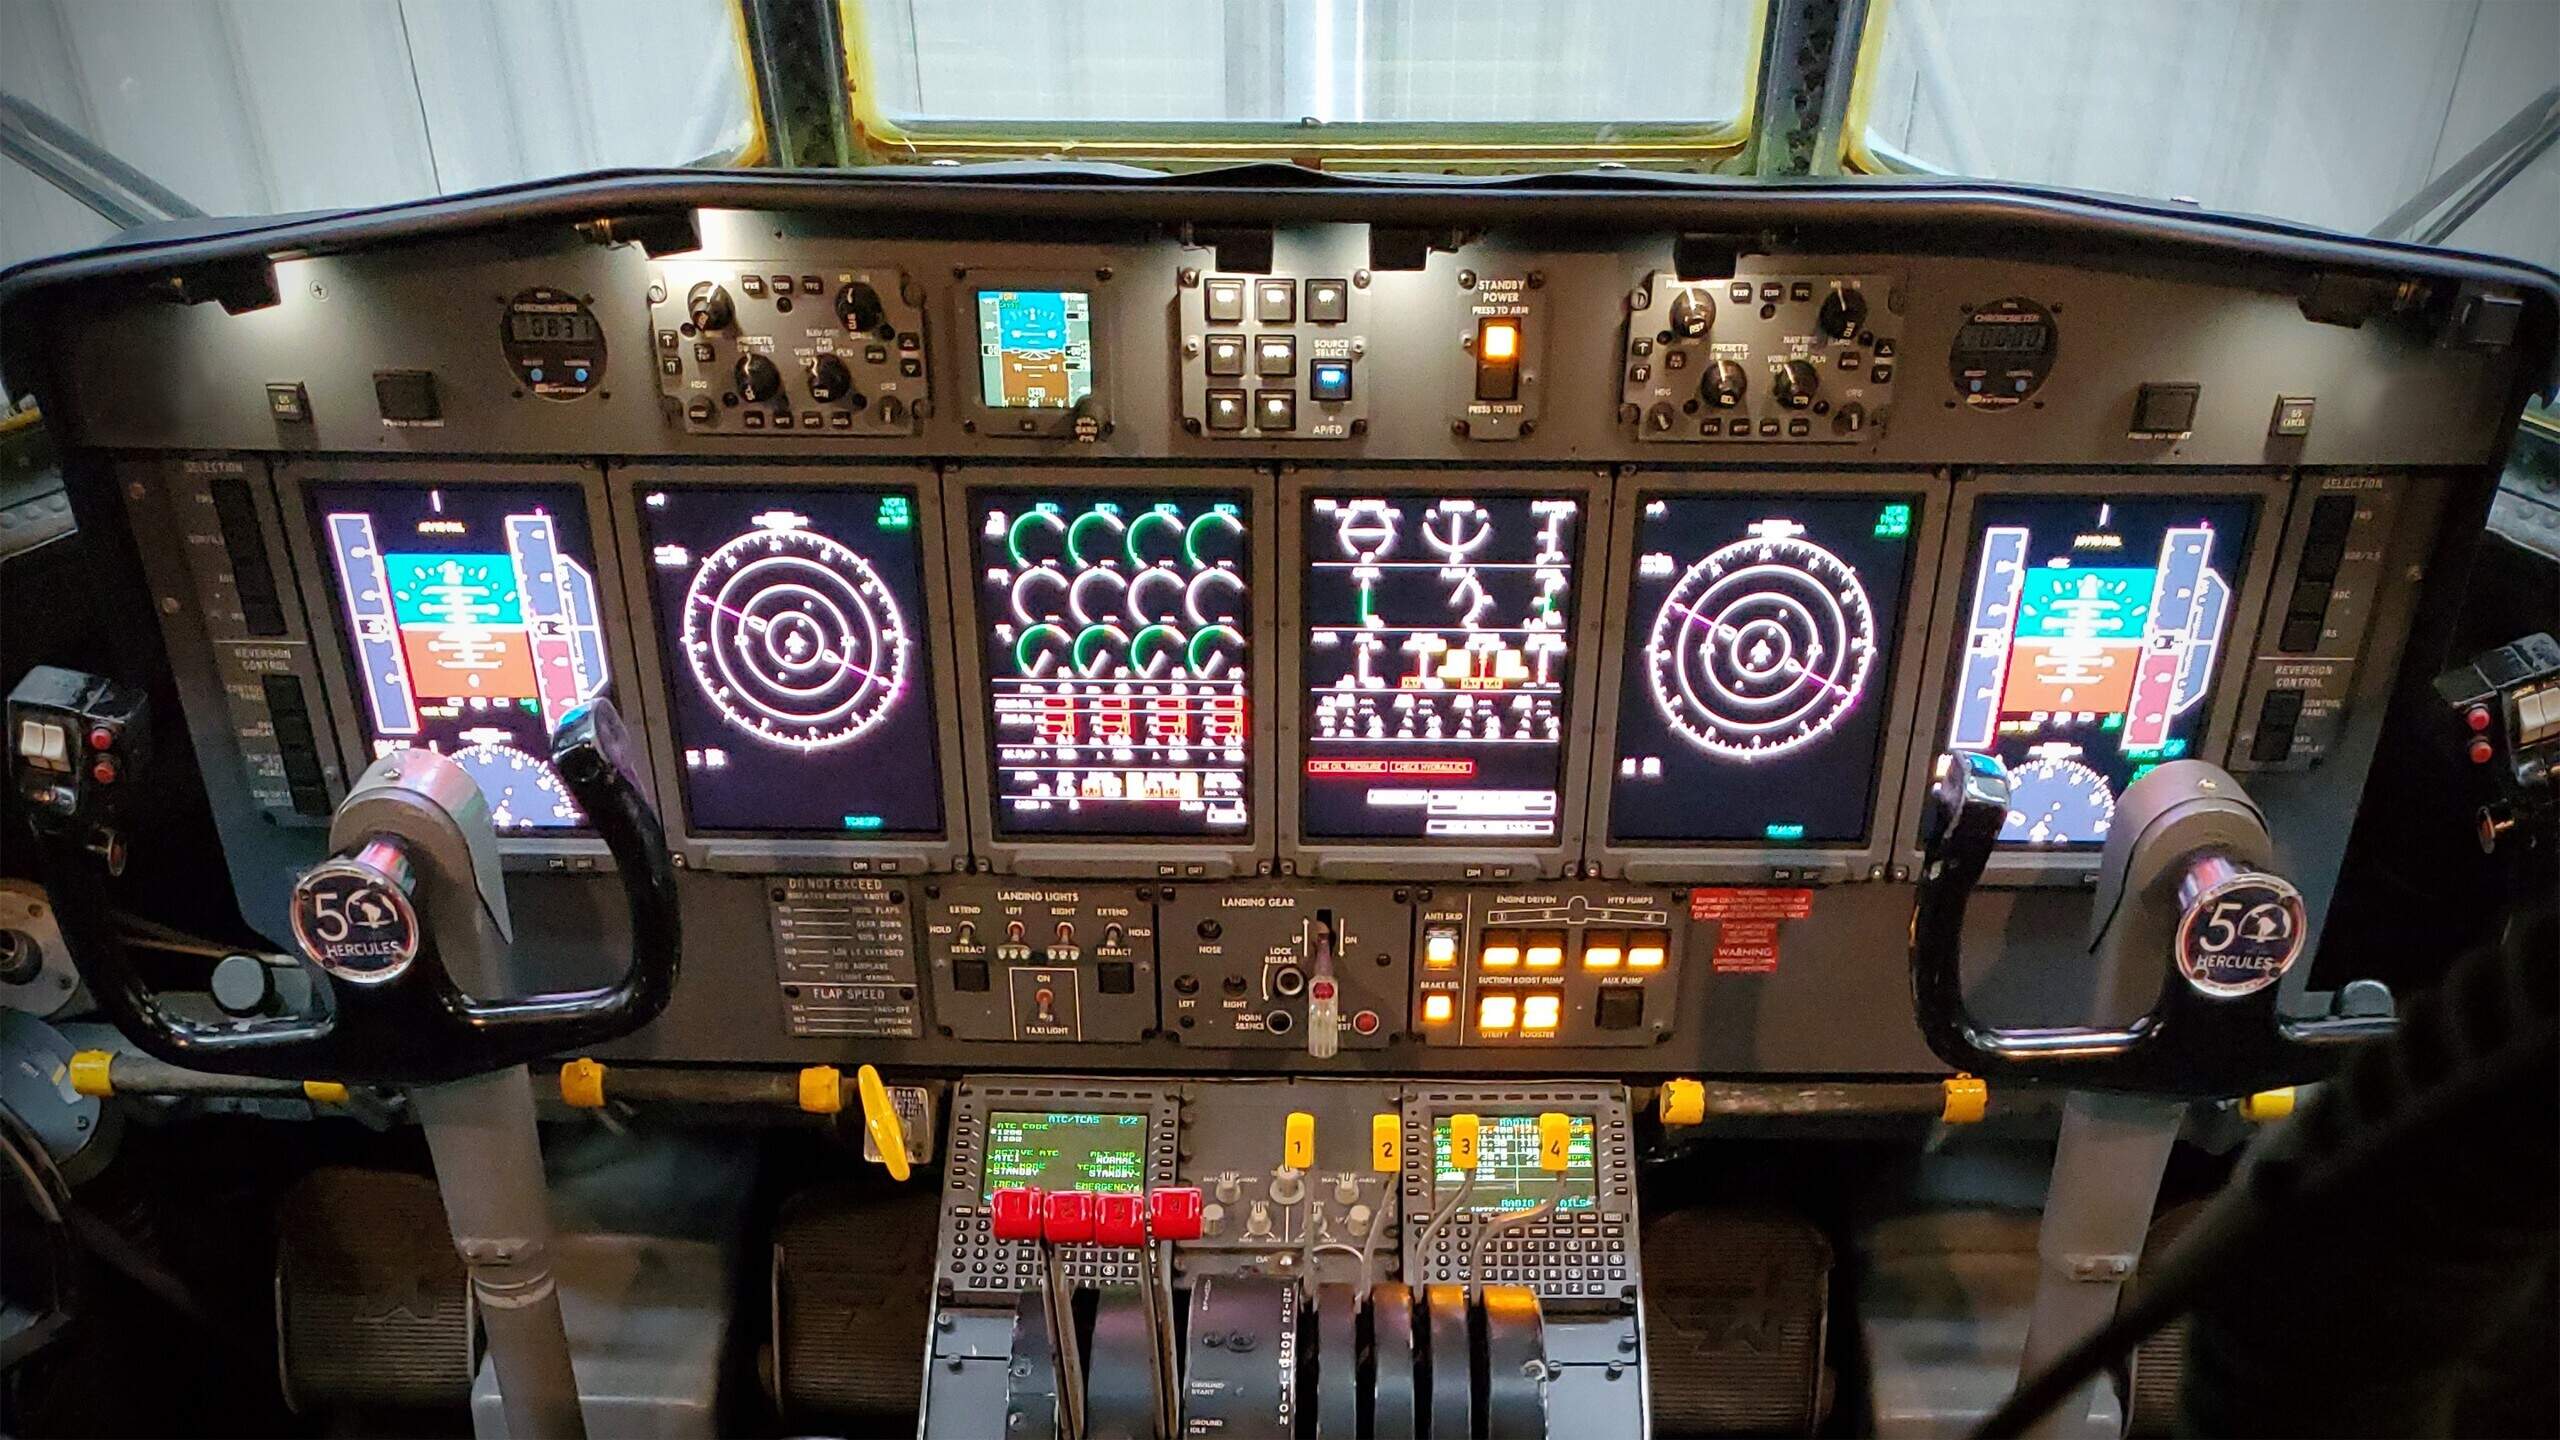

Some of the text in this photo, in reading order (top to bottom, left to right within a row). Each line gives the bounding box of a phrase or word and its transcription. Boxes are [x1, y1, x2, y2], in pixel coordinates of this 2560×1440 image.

[1478, 280, 1525, 290] STANDBY
[1483, 293, 1519, 303] POWER
[1472, 306, 1529, 315] PRESS TO ARM
[1314, 339, 1349, 348] SOURCE
[1712, 343, 1748, 352] PRESETS
[1315, 349, 1347, 357] SELECT
[1655, 388, 1672, 396] HDG
[1468, 405, 1524, 414] PRESS TO TEST
[1313, 425, 1343, 435] AP/FD
[2322, 478, 2383, 489] SELECTION
[234, 649, 291, 660] REVERSION
[242, 661, 290, 671] CONTROL
[2275, 665, 2333, 675] REVERSION
[2276, 678, 2323, 688] CONTROL
[789, 879, 882, 890] DO NOT EXCEED
[997, 891, 1079, 902] LANDING LIGHTS
[1496, 895, 1557, 905] ENGINE DRIVEN
[1607, 896, 1654, 905] HYD PUMPS
[1222, 897, 1295, 908] LANDING GEAR
[875, 906, 900, 915] FLAPS
[949, 905, 981, 915] EXTEND
[1005, 907, 1023, 916] LEFT
[1051, 908, 1076, 916] RIGHT
[1097, 908, 1129, 918] EXTEND
[1424, 911, 1464, 921] ANTI SKID
[929, 925, 952, 935] HOLD
[1128, 929, 1151, 938] HOLD
[1292, 936, 1303, 945] UP
[1344, 935, 1358, 945] DN
[325, 940, 402, 958] HERCULES
[950, 945, 986, 955] RETRACT
[1096, 948, 1131, 957] RETRACT
[1198, 945, 1222, 954] NOSE
[1270, 947, 1292, 956] LOCK
[1718, 947, 1773, 957] WARNING
[1264, 955, 1297, 964] RELEASE
[2196, 954, 2276, 970] HERCULES
[1036, 973, 1050, 983] ON
[1478, 976, 1565, 985] SUCTION BOOST PUMP
[1602, 976, 1644, 985] AUX PUMP
[1420, 980, 1459, 990] BRAKE SEL
[813, 988, 885, 1000] FLAP SPEED
[1179, 1001, 1195, 1009] LEFT
[1223, 1001, 1248, 1009] RIGHT
[1238, 1014, 1262, 1022] HORN
[1026, 1026, 1069, 1035] TAXI LIGHT
[1235, 1022, 1265, 1031] SILENCE
[1481, 1030, 1509, 1040] UTILITY
[1519, 1030, 1555, 1040] BOOSTER
[1048, 1115, 1139, 1125] ATC/TCAS 1/2
[1499, 1118, 1532, 1127] RADIO
[997, 1122, 1049, 1131] ATC CODE
[1294, 1140, 1302, 1154] 1
[1382, 1142, 1393, 1158] 2
[1461, 1137, 1471, 1154] 3
[1550, 1140, 1561, 1157] 4
[1096, 1156, 1135, 1165] NORMAL
[993, 1168, 1040, 1177] STANDBY
[1088, 1170, 1135, 1178] STANDBY
[1075, 1182, 1134, 1191] EMERGENCY
[1501, 1198, 1535, 1208] RADIO
[1485, 1241, 1492, 1250] A
[1506, 1241, 1513, 1250] B
[1527, 1241, 1535, 1250] C
[1548, 1241, 1556, 1250] D
[1612, 1241, 1620, 1250] G
[1127, 1252, 1136, 1261] M
[1485, 1256, 1492, 1265] H
[1548, 1255, 1556, 1264] K
[1591, 1255, 1599, 1264] M
[1506, 1270, 1514, 1278] P
[1549, 1269, 1557, 1278] R
[1613, 1270, 1621, 1278] U
[1571, 1284, 1579, 1293] Z
[1590, 1284, 1602, 1292] CLR
[1278, 1331, 1293, 1425] CONDITION
[1191, 1381, 1225, 1389] GROUND
[1190, 1419, 1223, 1427] GROUND
